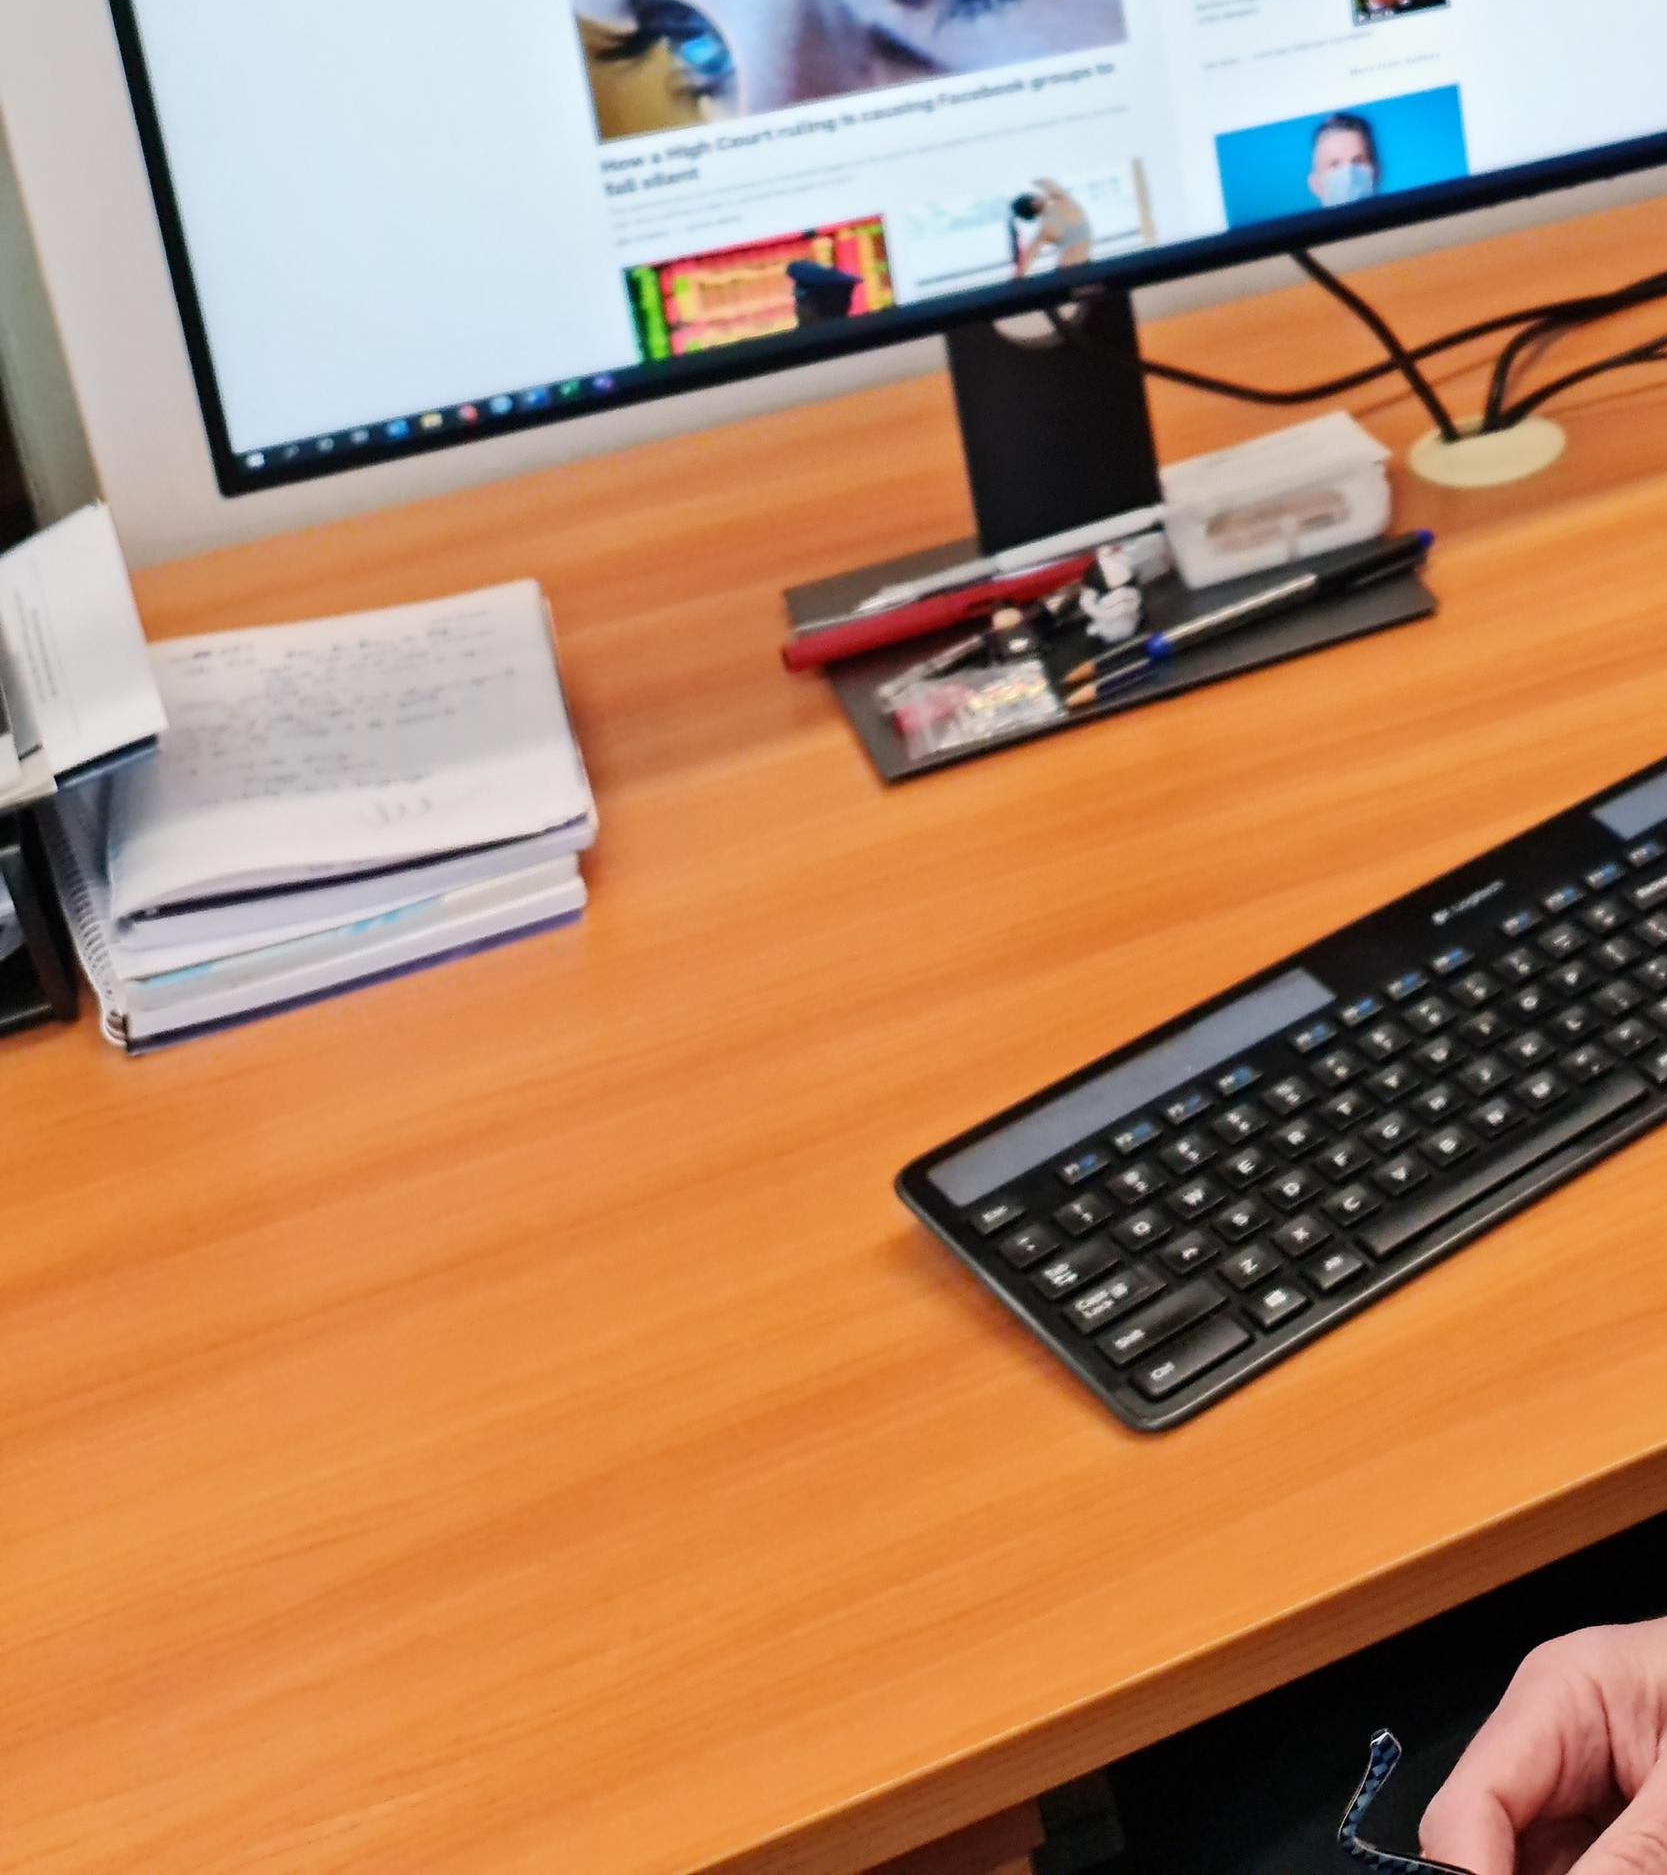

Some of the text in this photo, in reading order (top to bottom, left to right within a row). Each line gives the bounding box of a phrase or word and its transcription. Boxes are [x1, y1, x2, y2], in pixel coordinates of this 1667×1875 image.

[601, 155, 645, 172] How
[717, 130, 773, 151] Court
[774, 117, 837, 138] ruling
[938, 78, 1025, 105] Facebook
[1030, 67, 1094, 92] groups
[643, 167, 700, 191] silent
